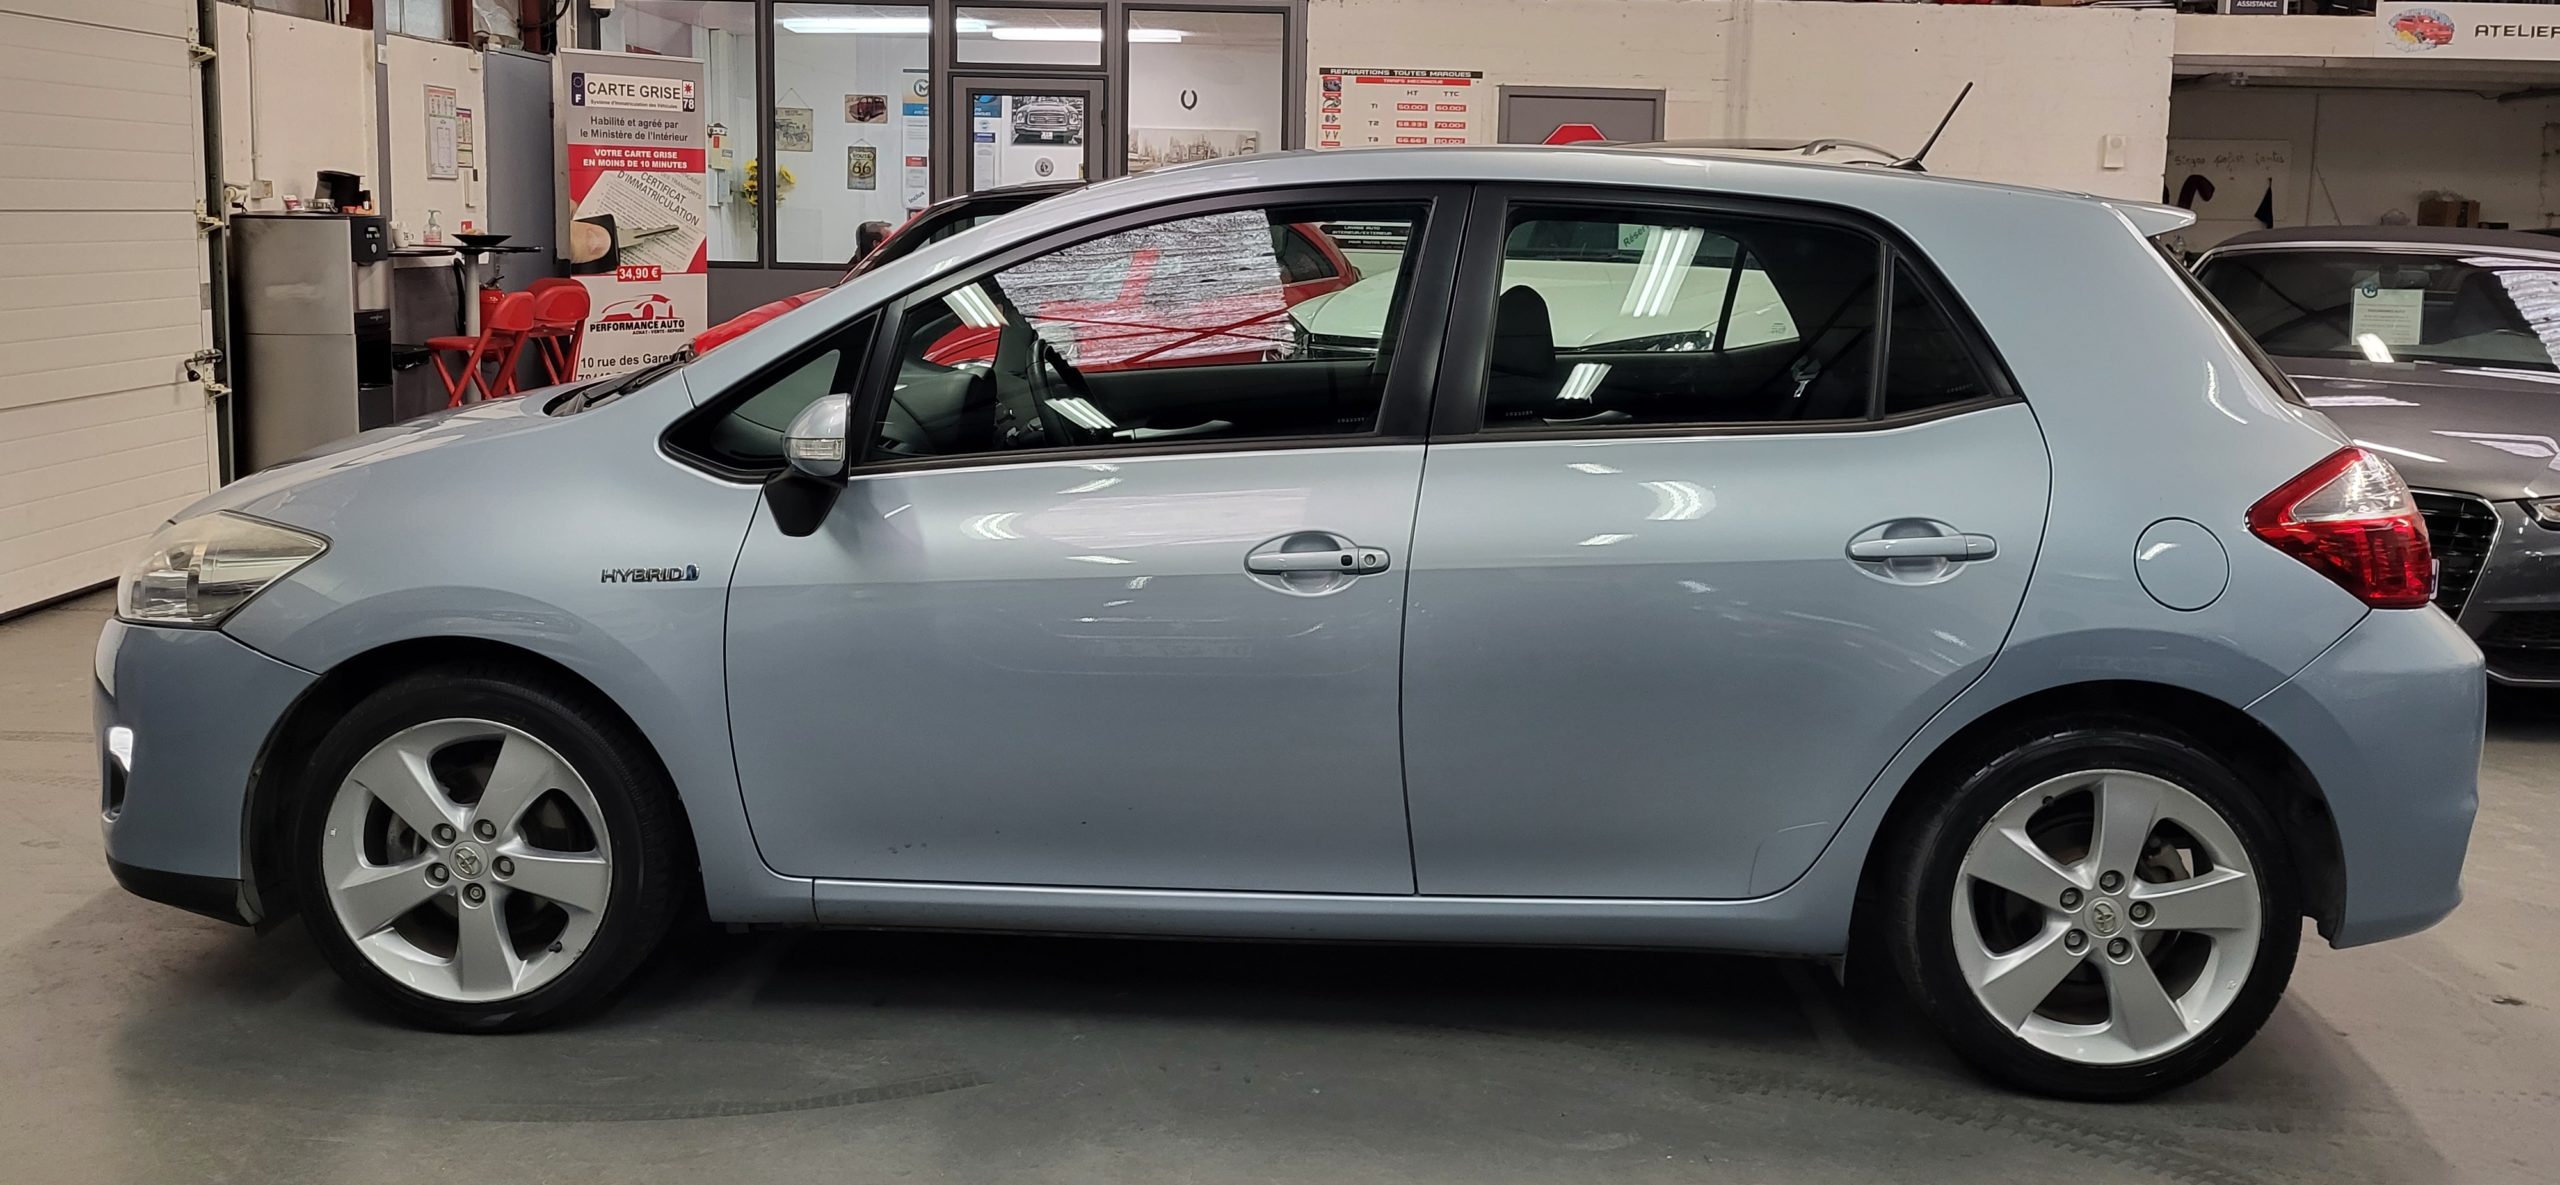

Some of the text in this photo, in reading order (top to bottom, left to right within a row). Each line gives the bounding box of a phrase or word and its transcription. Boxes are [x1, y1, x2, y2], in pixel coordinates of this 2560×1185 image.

[587, 82, 680, 99] CARTE GRISE
[575, 94, 582, 103] F
[683, 99, 694, 109] 78
[591, 116, 679, 130] Habilité et agréé par
[580, 129, 688, 142] le Ministère de l'Intérieur
[594, 149, 622, 157] VOTRE
[624, 150, 651, 158] CARTE
[852, 161, 871, 174] 66
[641, 172, 686, 203] CERTIFICAT
[617, 170, 699, 226] D'IMMATRICULATION
[619, 268, 659, 280] 34,90 €
[590, 320, 685, 332] PERFORMANCE AUTO
[581, 357, 594, 368] 10
[597, 358, 616, 367] rue
[620, 355, 639, 366] des
[601, 568, 684, 583] HYBRID
